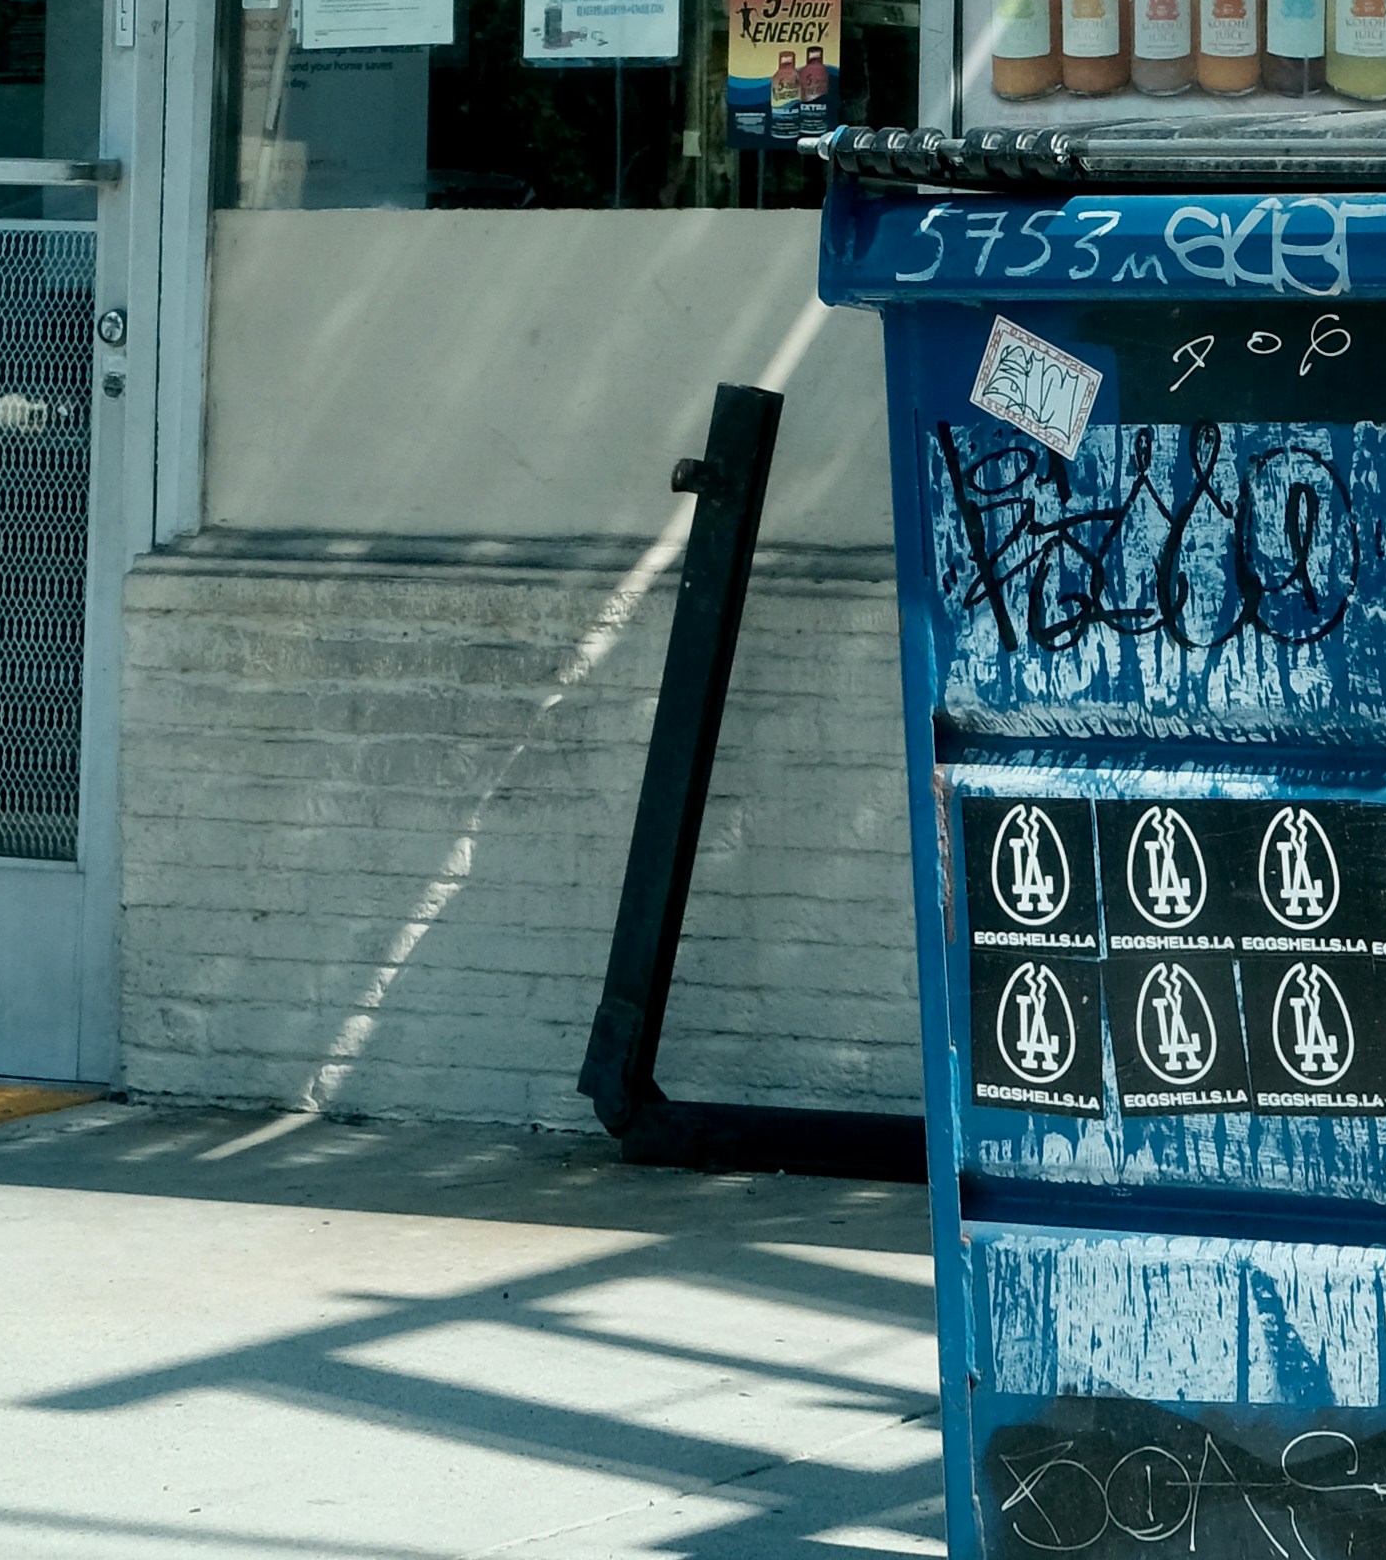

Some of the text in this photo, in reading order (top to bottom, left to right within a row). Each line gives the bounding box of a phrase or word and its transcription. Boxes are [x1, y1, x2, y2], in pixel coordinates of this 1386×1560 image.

[752, 19, 829, 44] ENERGY
[974, 932, 1095, 949] EGGSHELLS.LA
[1111, 934, 1234, 951] EGGSHELLS.LA
[1242, 938, 1367, 953] EGGSHELLS.LA
[976, 1083, 1099, 1109] EGGSHELLS.LA
[1124, 1089, 1247, 1108] EGGSHELLS.LA
[1257, 1092, 1384, 1108] EGGSHELLS.LA
